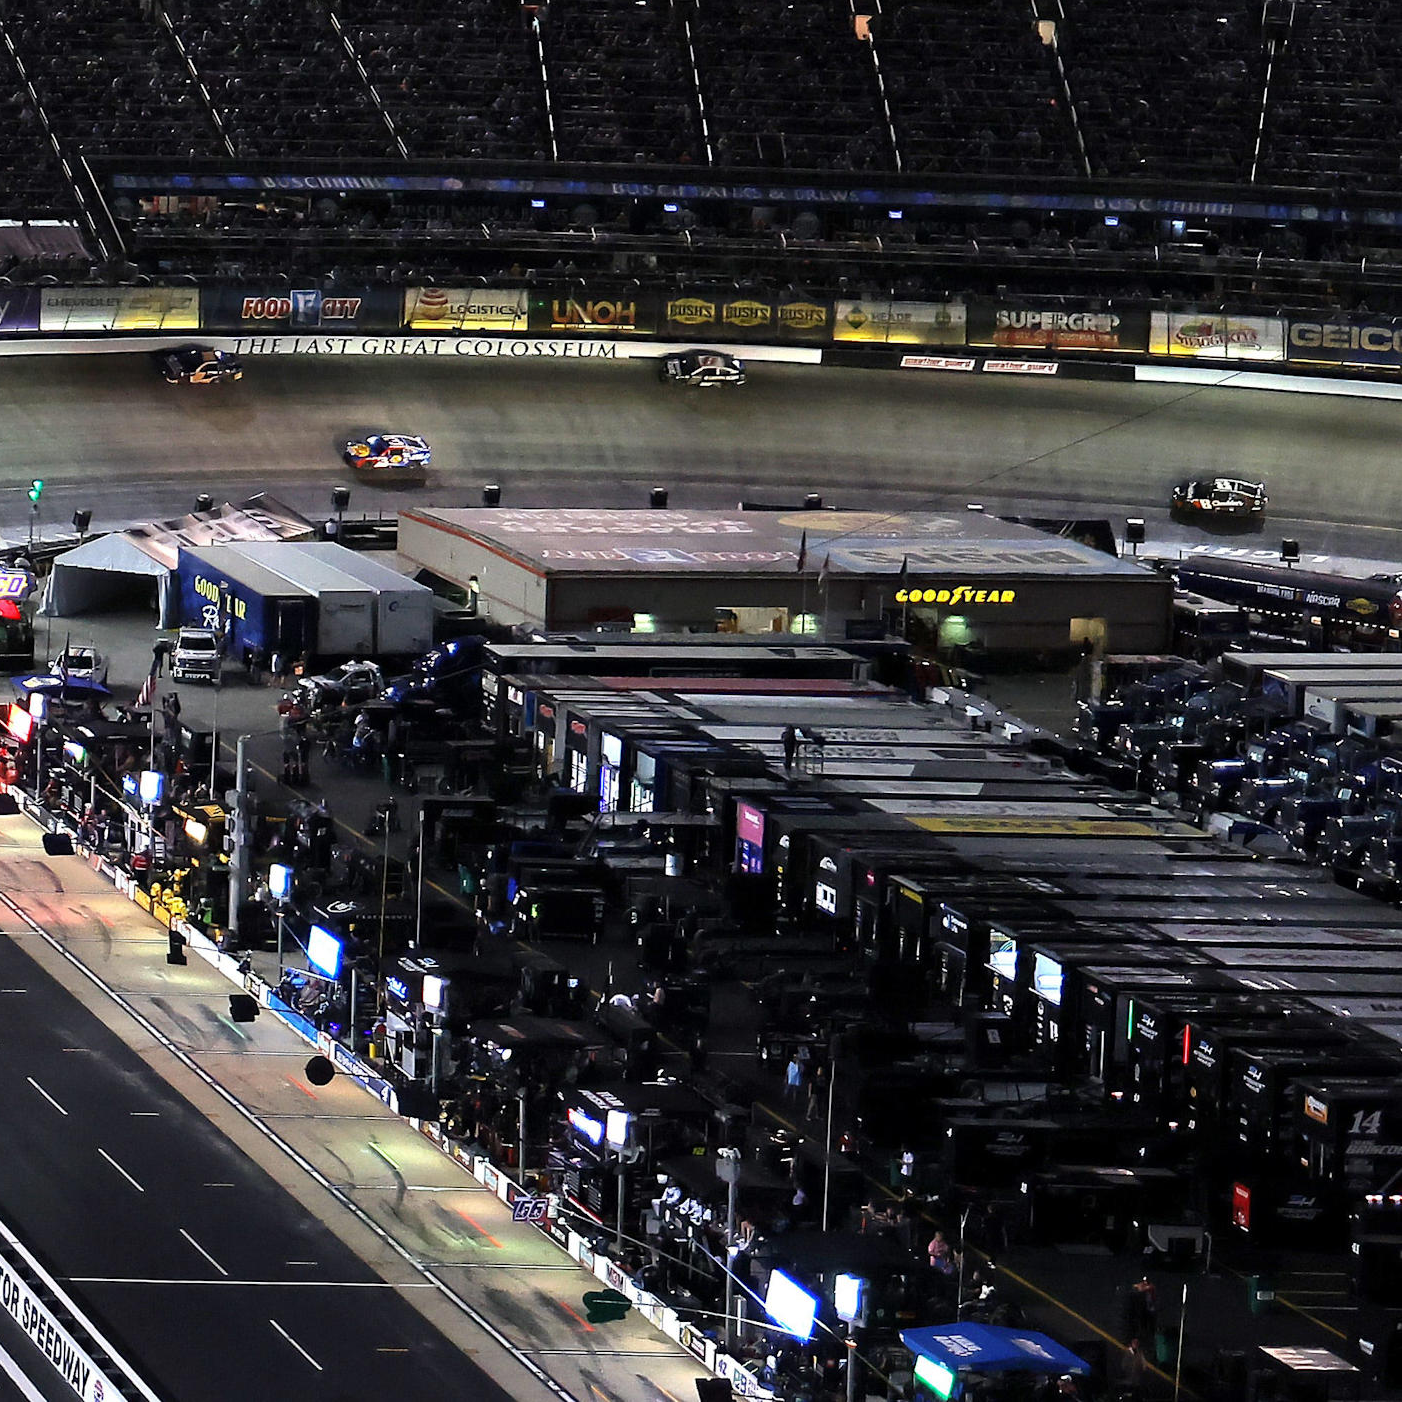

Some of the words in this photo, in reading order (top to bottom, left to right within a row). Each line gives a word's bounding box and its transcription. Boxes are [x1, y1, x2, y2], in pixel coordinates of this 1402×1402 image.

[241, 297, 292, 320] FOOD
[321, 297, 362, 318] CITY
[449, 303, 516, 316] LOGISTICS
[551, 299, 636, 325] UNOH
[233, 337, 282, 356] THE
[294, 337, 354, 356] LAST
[362, 338, 445, 356] GREAT
[455, 339, 618, 359] COLOSSEUM
[895, 585, 1015, 606] GOODYEAR
[1306, 590, 1341, 608] NASCAR
[1349, 1110, 1384, 1135] 14
[22, 1295, 91, 1399] SPEEDWAY
